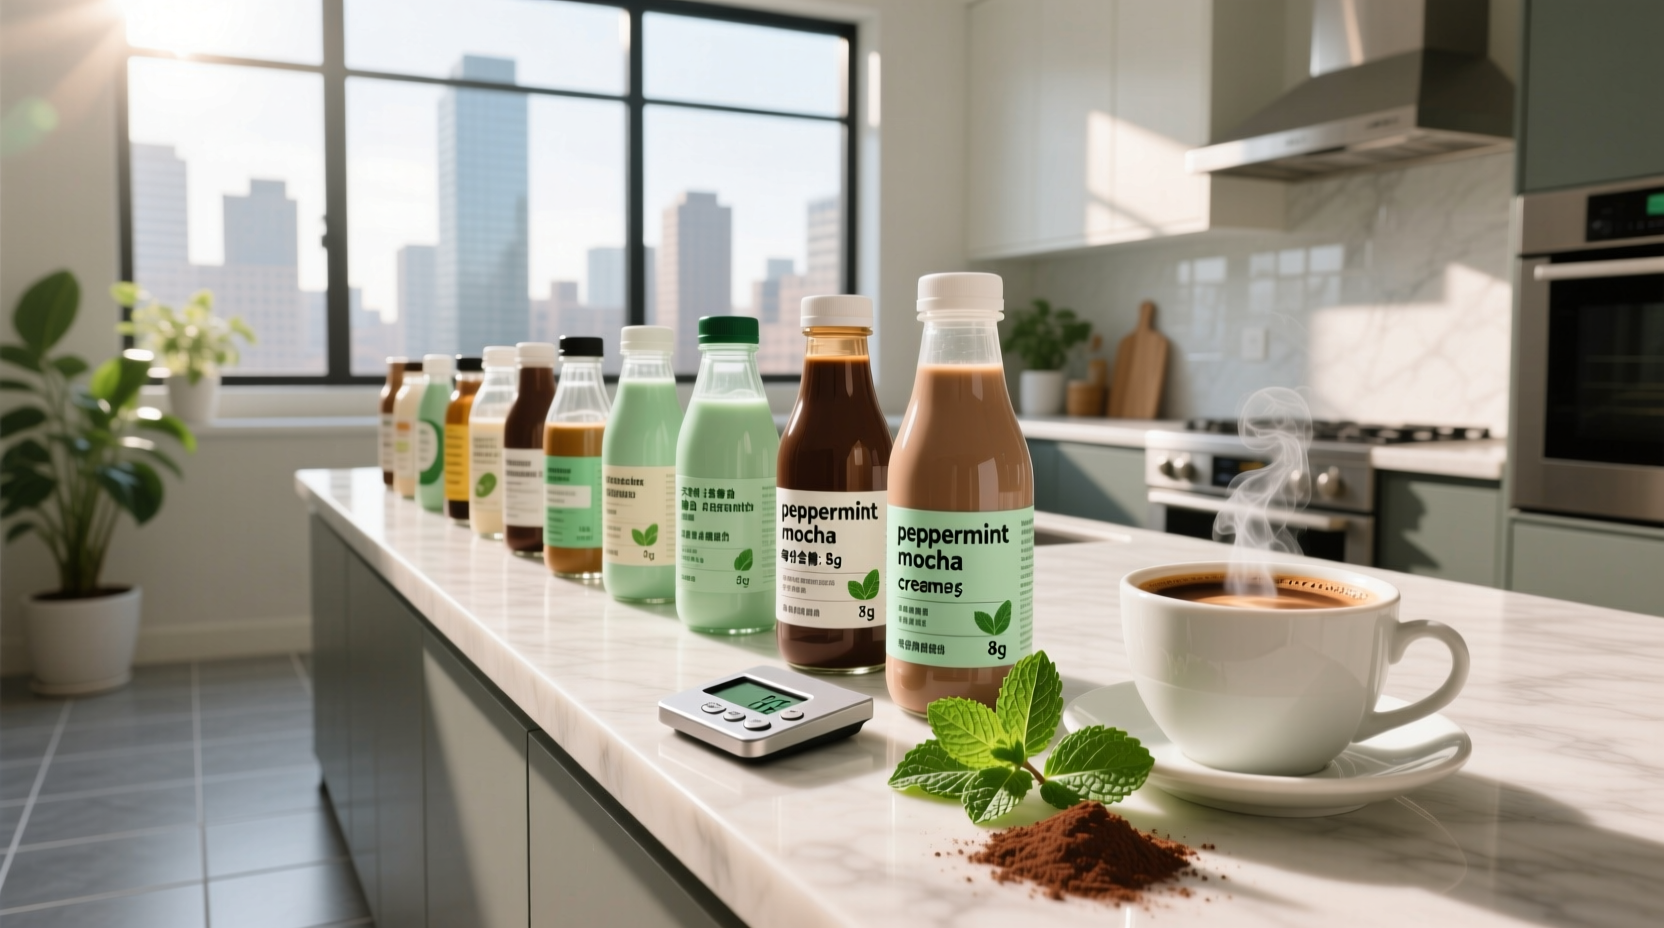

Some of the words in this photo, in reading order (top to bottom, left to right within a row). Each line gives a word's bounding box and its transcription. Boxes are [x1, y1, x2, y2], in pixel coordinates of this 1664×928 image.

[781, 500, 878, 524] peppermint
[782, 524, 836, 544] mocha
[897, 522, 1009, 549] peppermint
[897, 549, 963, 571] mocha
[987, 640, 1007, 660] 8g
